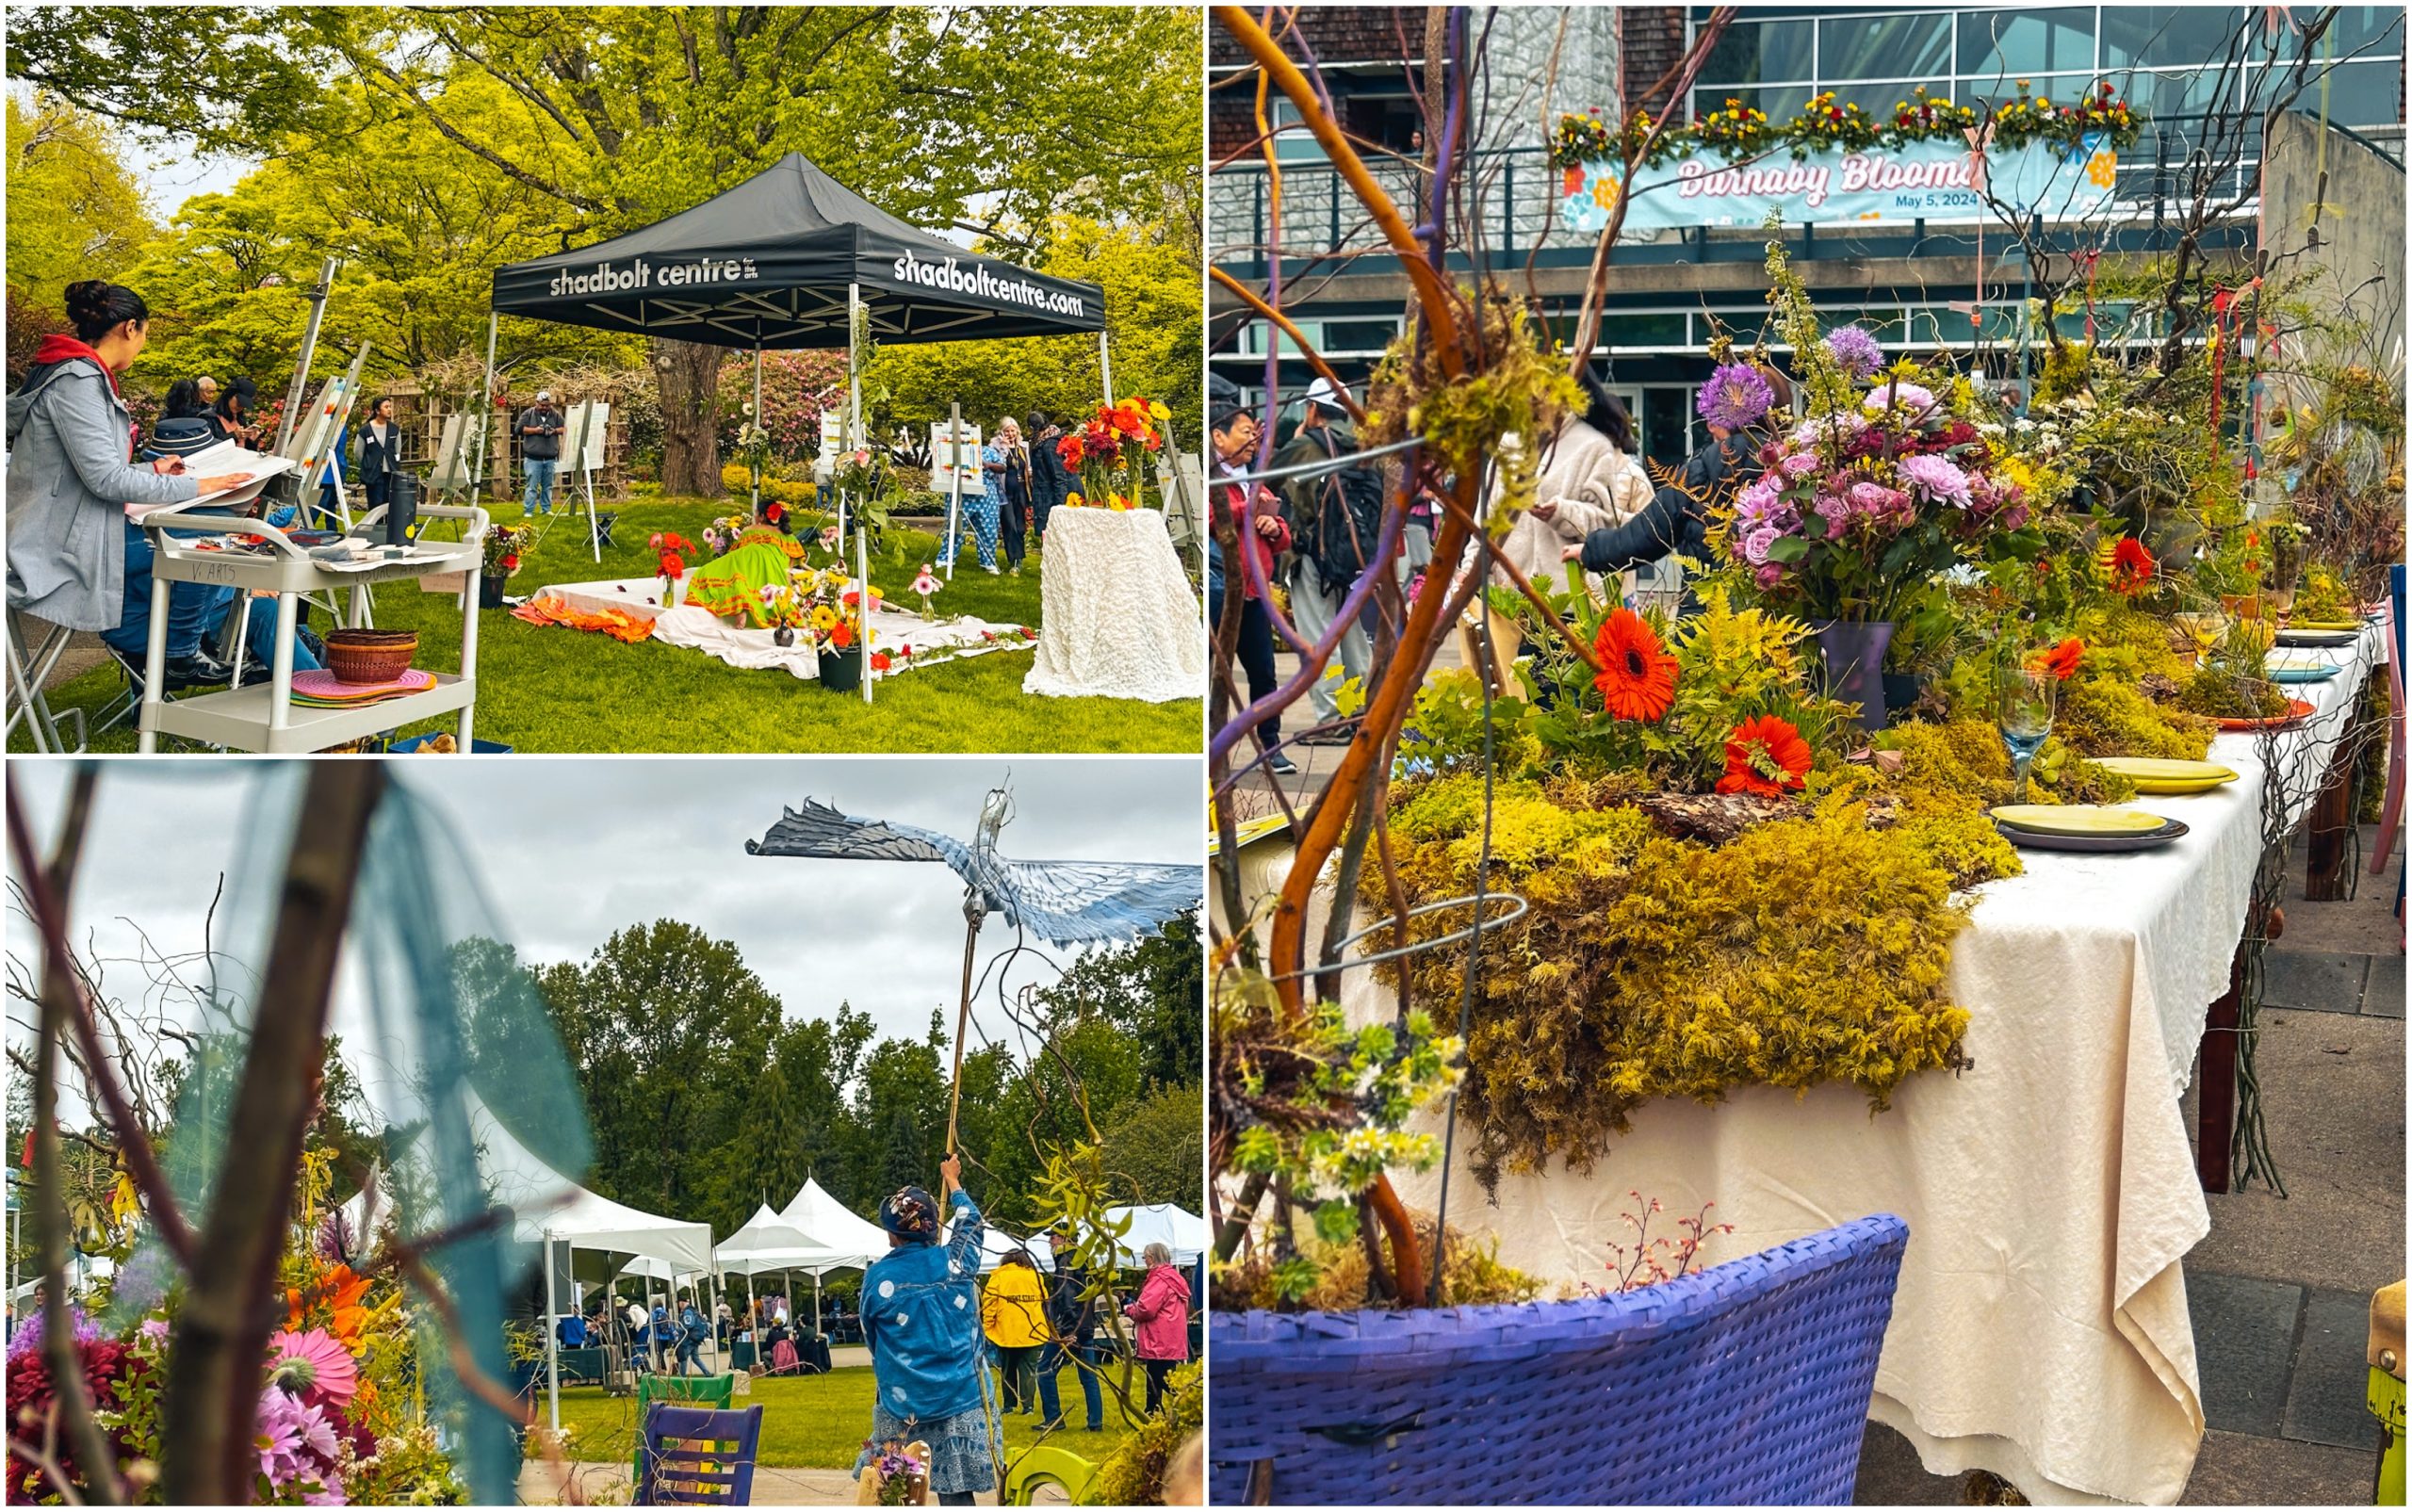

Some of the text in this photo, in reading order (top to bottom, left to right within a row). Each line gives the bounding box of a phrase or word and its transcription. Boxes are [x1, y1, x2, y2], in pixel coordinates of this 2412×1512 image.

[1678, 159, 1829, 207] Burnaby
[1896, 193, 1978, 208] May 5, 2024
[550, 258, 741, 296] shadbolt centre
[894, 249, 1084, 317] shadboltcentre.com
[206, 563, 236, 582] ARTS
